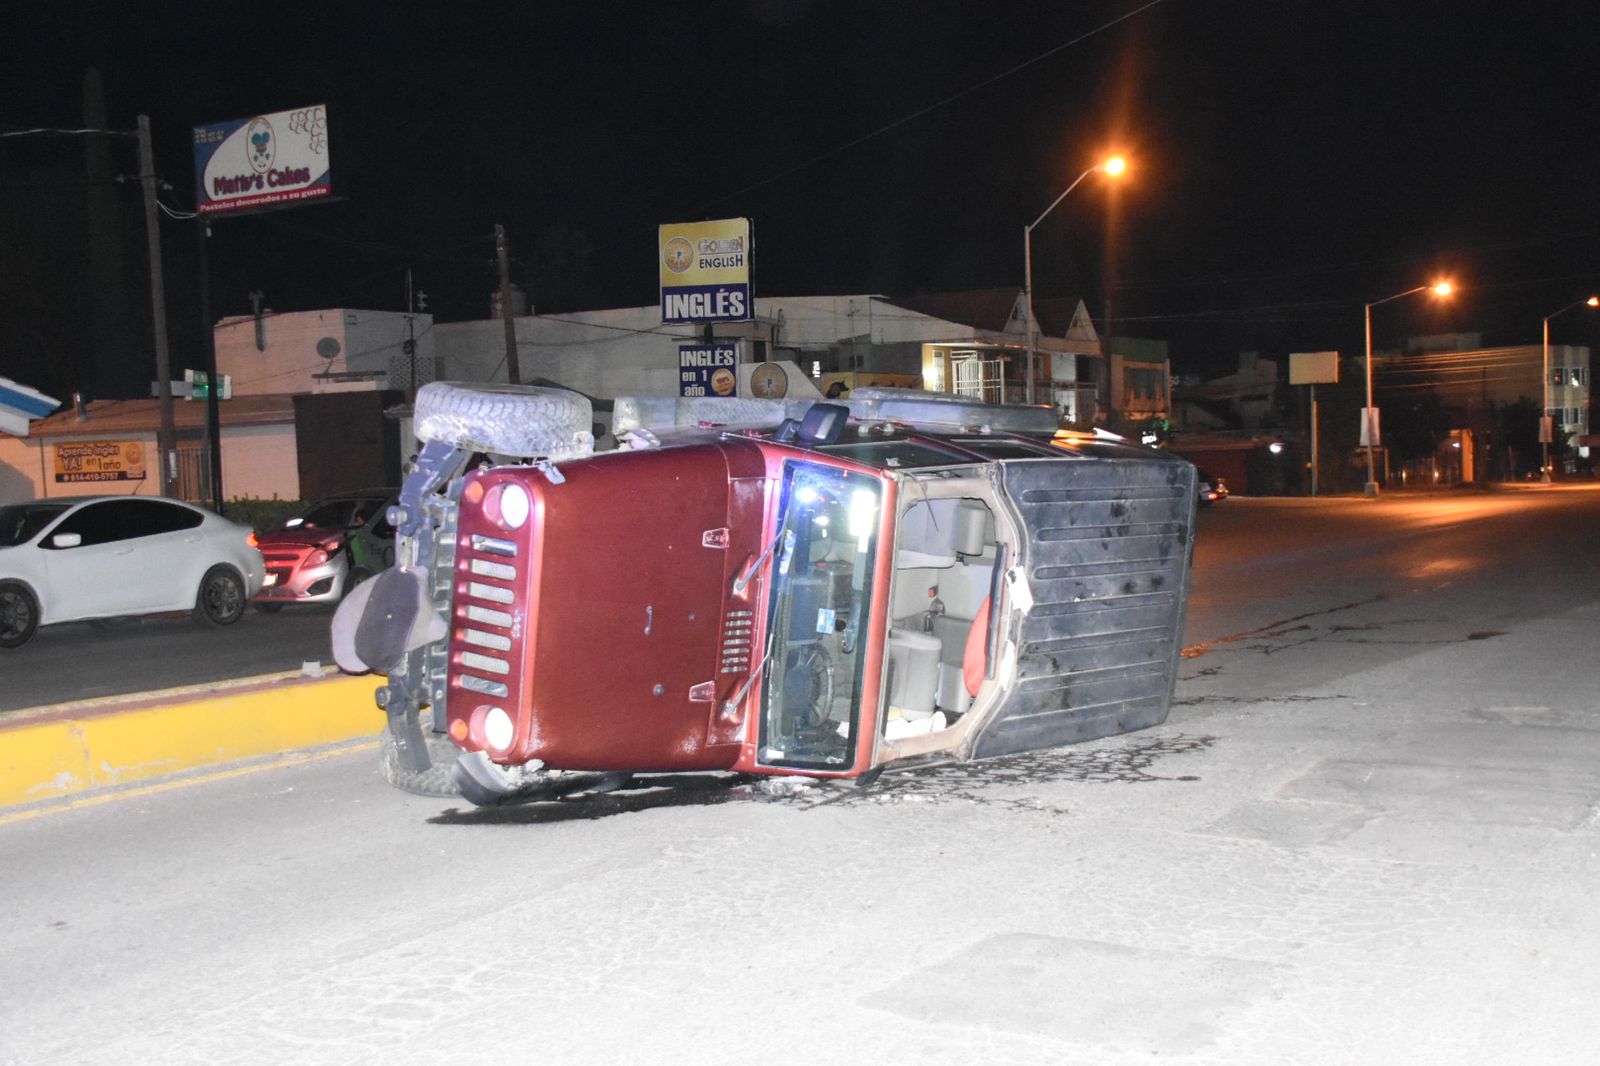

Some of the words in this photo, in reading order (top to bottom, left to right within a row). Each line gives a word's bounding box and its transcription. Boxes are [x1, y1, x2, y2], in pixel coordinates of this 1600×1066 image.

[267, 167, 310, 187] Cakes
[200, 201, 234, 212] Pasteles
[236, 195, 279, 207] decorados
[301, 188, 327, 198] gusto
[699, 254, 743, 269] ENGLISH
[665, 288, 745, 319] INGLÉS
[680, 347, 734, 367] INGLÉS
[682, 371, 696, 382] en
[702, 369, 708, 382] 1
[684, 384, 705, 397] año
[59, 445, 93, 456] Aprende
[63, 458, 81, 470] YA!
